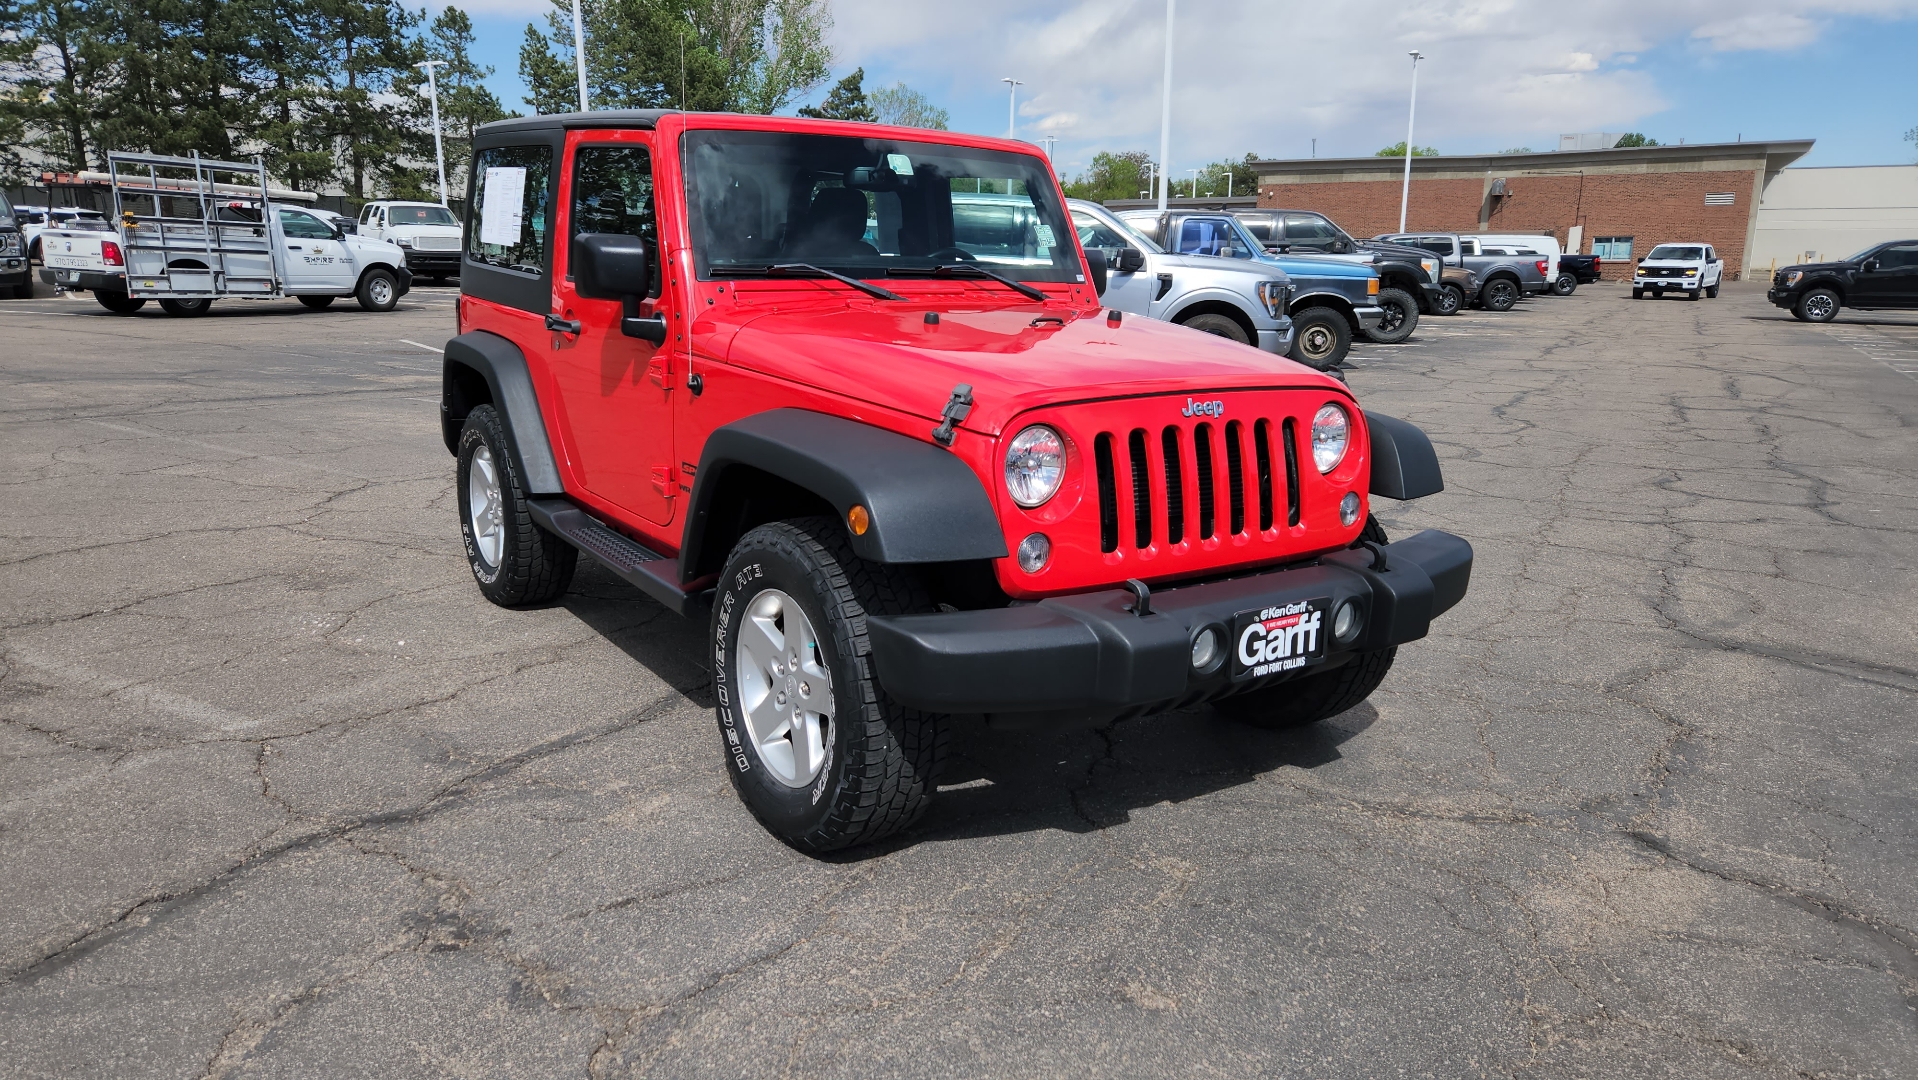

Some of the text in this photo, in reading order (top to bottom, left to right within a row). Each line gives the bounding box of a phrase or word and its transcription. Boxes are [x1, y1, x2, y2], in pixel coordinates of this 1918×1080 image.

[1181, 397, 1225, 418] Jeep
[1268, 606, 1286, 620] Ken
[1285, 601, 1307, 616] Garff
[1238, 610, 1322, 667] Garff
[715, 563, 763, 772] DISCOVERER AT3
[1253, 656, 1306, 677] FORD FORT COLLINS
